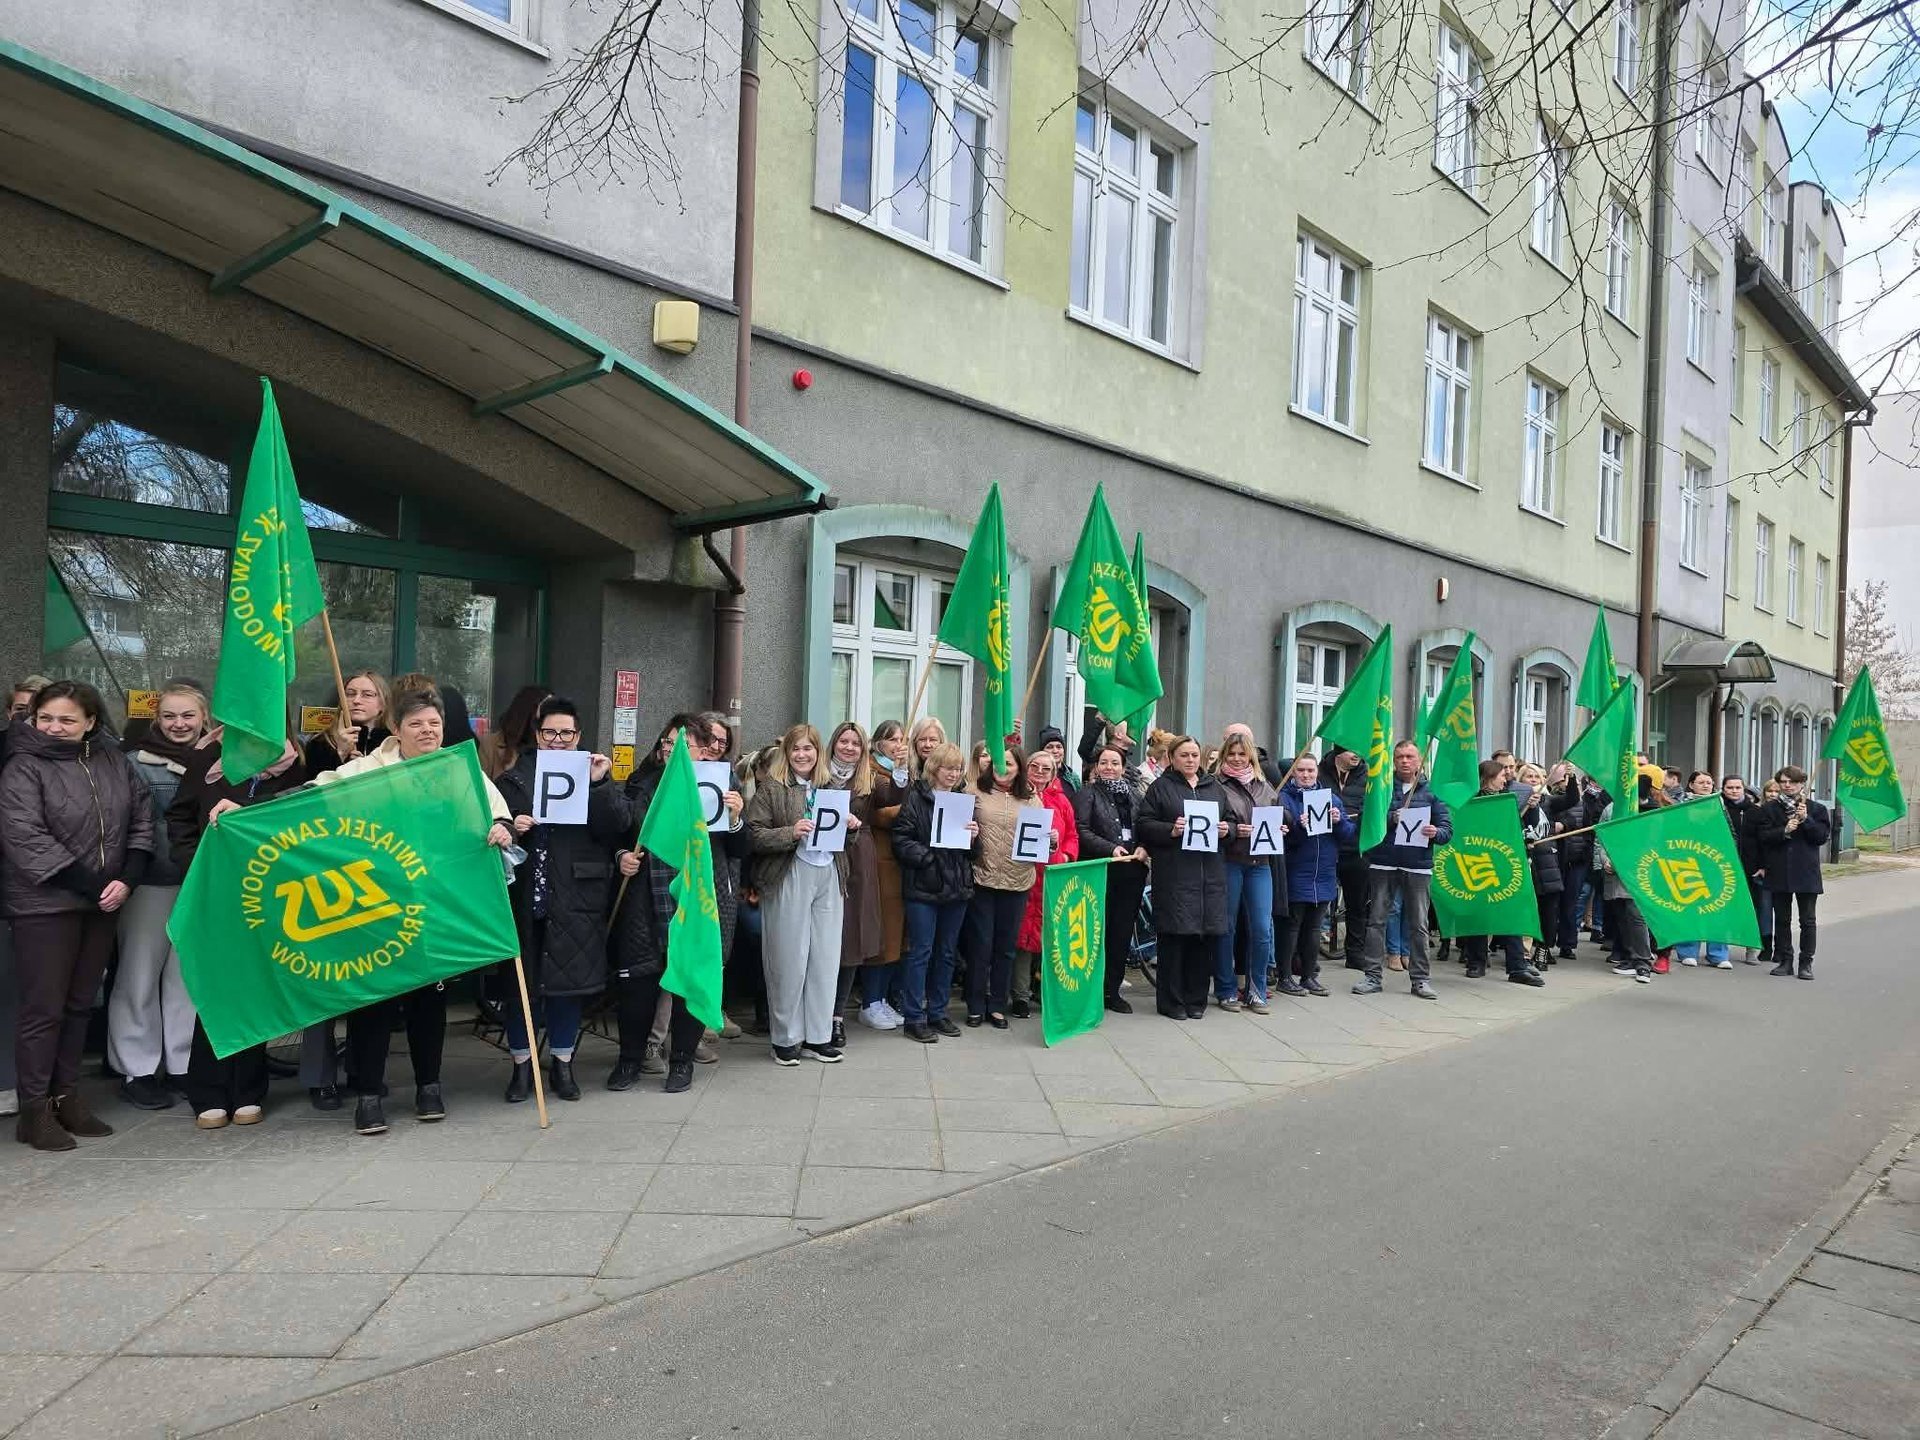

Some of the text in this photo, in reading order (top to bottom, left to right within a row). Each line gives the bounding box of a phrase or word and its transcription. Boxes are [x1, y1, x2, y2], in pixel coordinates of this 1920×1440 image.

[541, 772, 575, 818] P
[812, 808, 841, 847] P
[935, 807, 944, 844] I
[1187, 814, 1210, 848] R
[1252, 820, 1277, 851] A
[1307, 801, 1332, 832] M
[1400, 819, 1422, 843] Y
[1016, 822, 1043, 858] E
[1454, 852, 1501, 892] ZUS
[1487, 857, 1524, 904] ZAWODOWY
[1657, 857, 1711, 904] ZUS
[1666, 839, 1737, 915] ZWIĄZEK ZAWODOWY
